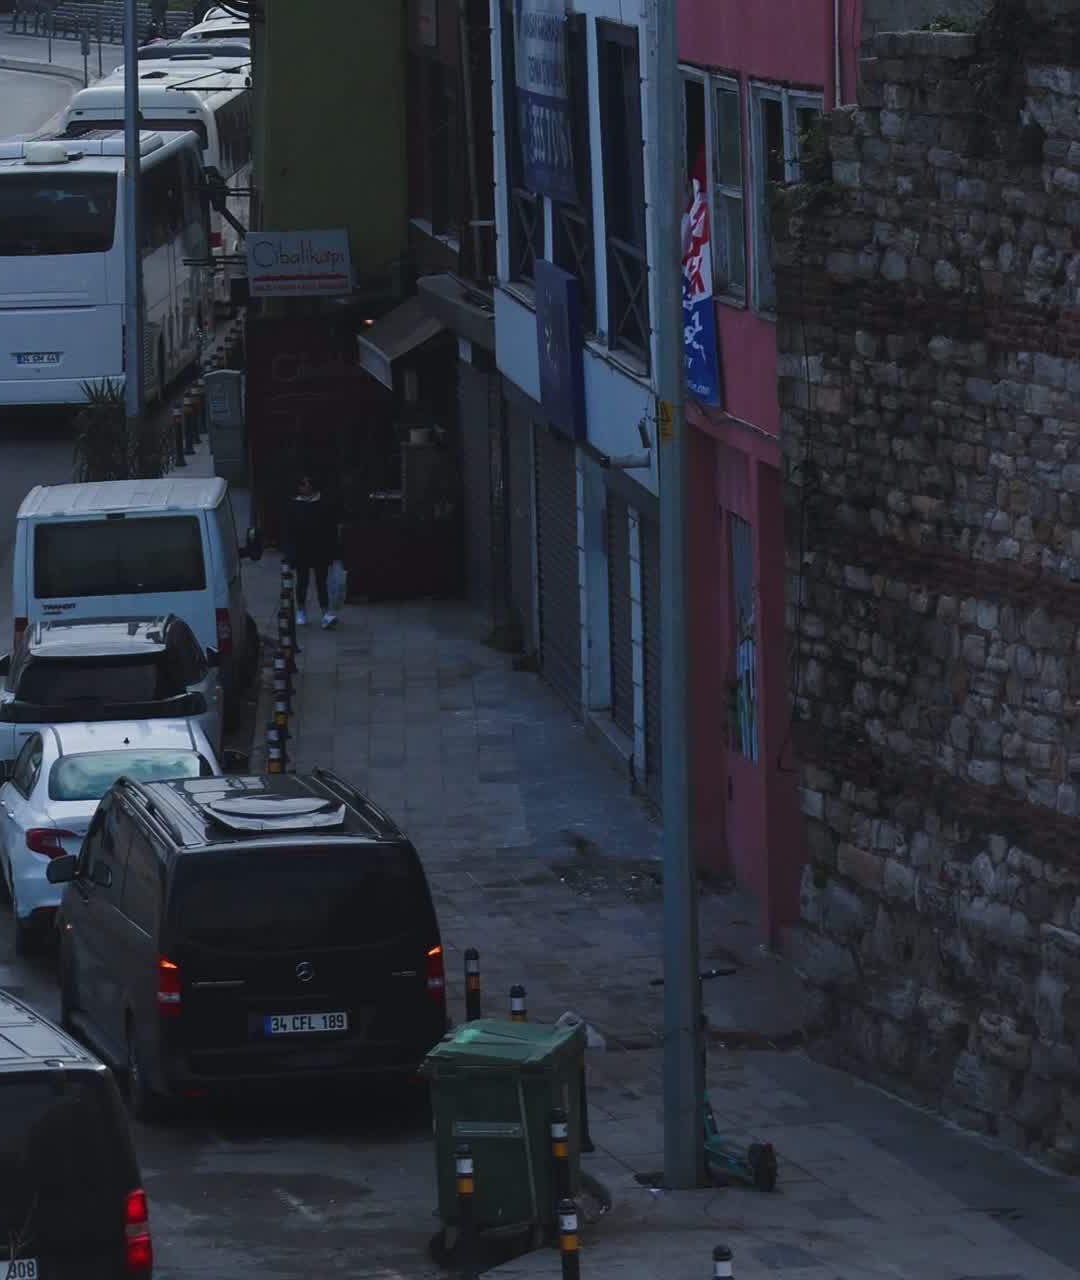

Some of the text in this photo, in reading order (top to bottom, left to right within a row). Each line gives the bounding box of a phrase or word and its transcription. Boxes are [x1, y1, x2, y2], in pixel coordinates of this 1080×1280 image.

[272, 1014, 345, 1031] 34 CFL 189
